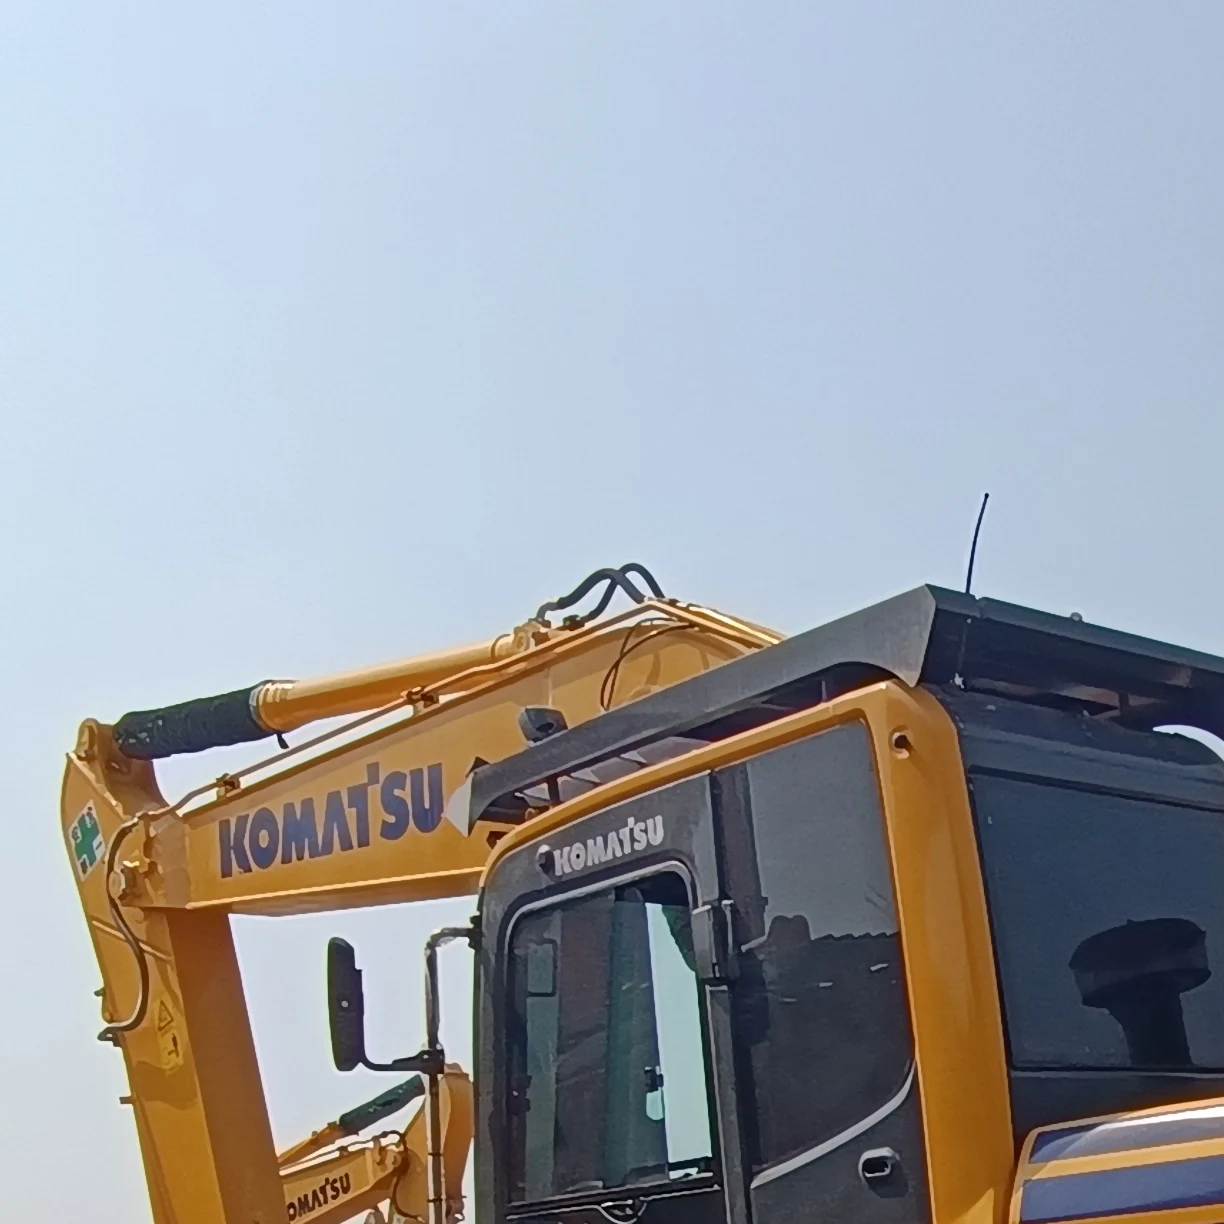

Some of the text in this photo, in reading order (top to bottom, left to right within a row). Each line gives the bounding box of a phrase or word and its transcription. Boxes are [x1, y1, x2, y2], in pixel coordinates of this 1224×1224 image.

[218, 761, 444, 879] KOMATSU
[552, 814, 665, 877] KOMATSU
[286, 1172, 351, 1222] OMATSU
